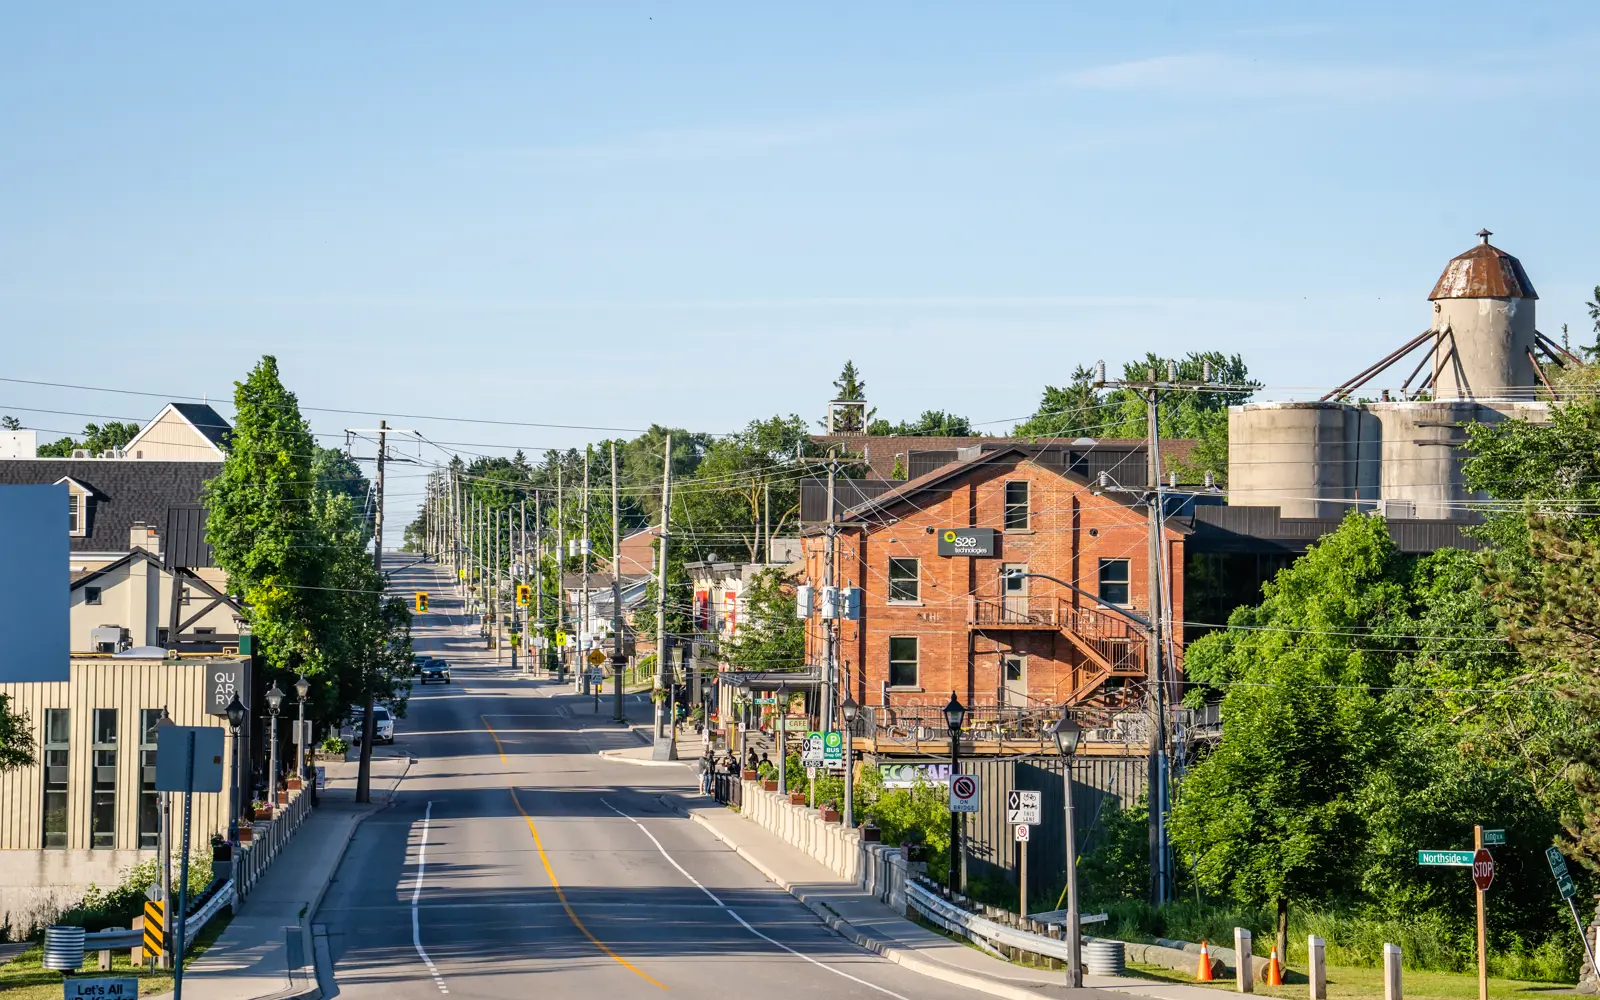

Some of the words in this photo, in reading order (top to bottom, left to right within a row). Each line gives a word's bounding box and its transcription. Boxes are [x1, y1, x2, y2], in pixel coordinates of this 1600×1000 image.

[954, 537, 977, 547] s2e
[214, 672, 235, 683] QU
[215, 683, 235, 694] AR
[1485, 832, 1496, 843] King
[1423, 853, 1461, 863] Northside
[1474, 861, 1492, 878] STOP
[77, 984, 105, 995] Let's
[108, 984, 123, 995] All
